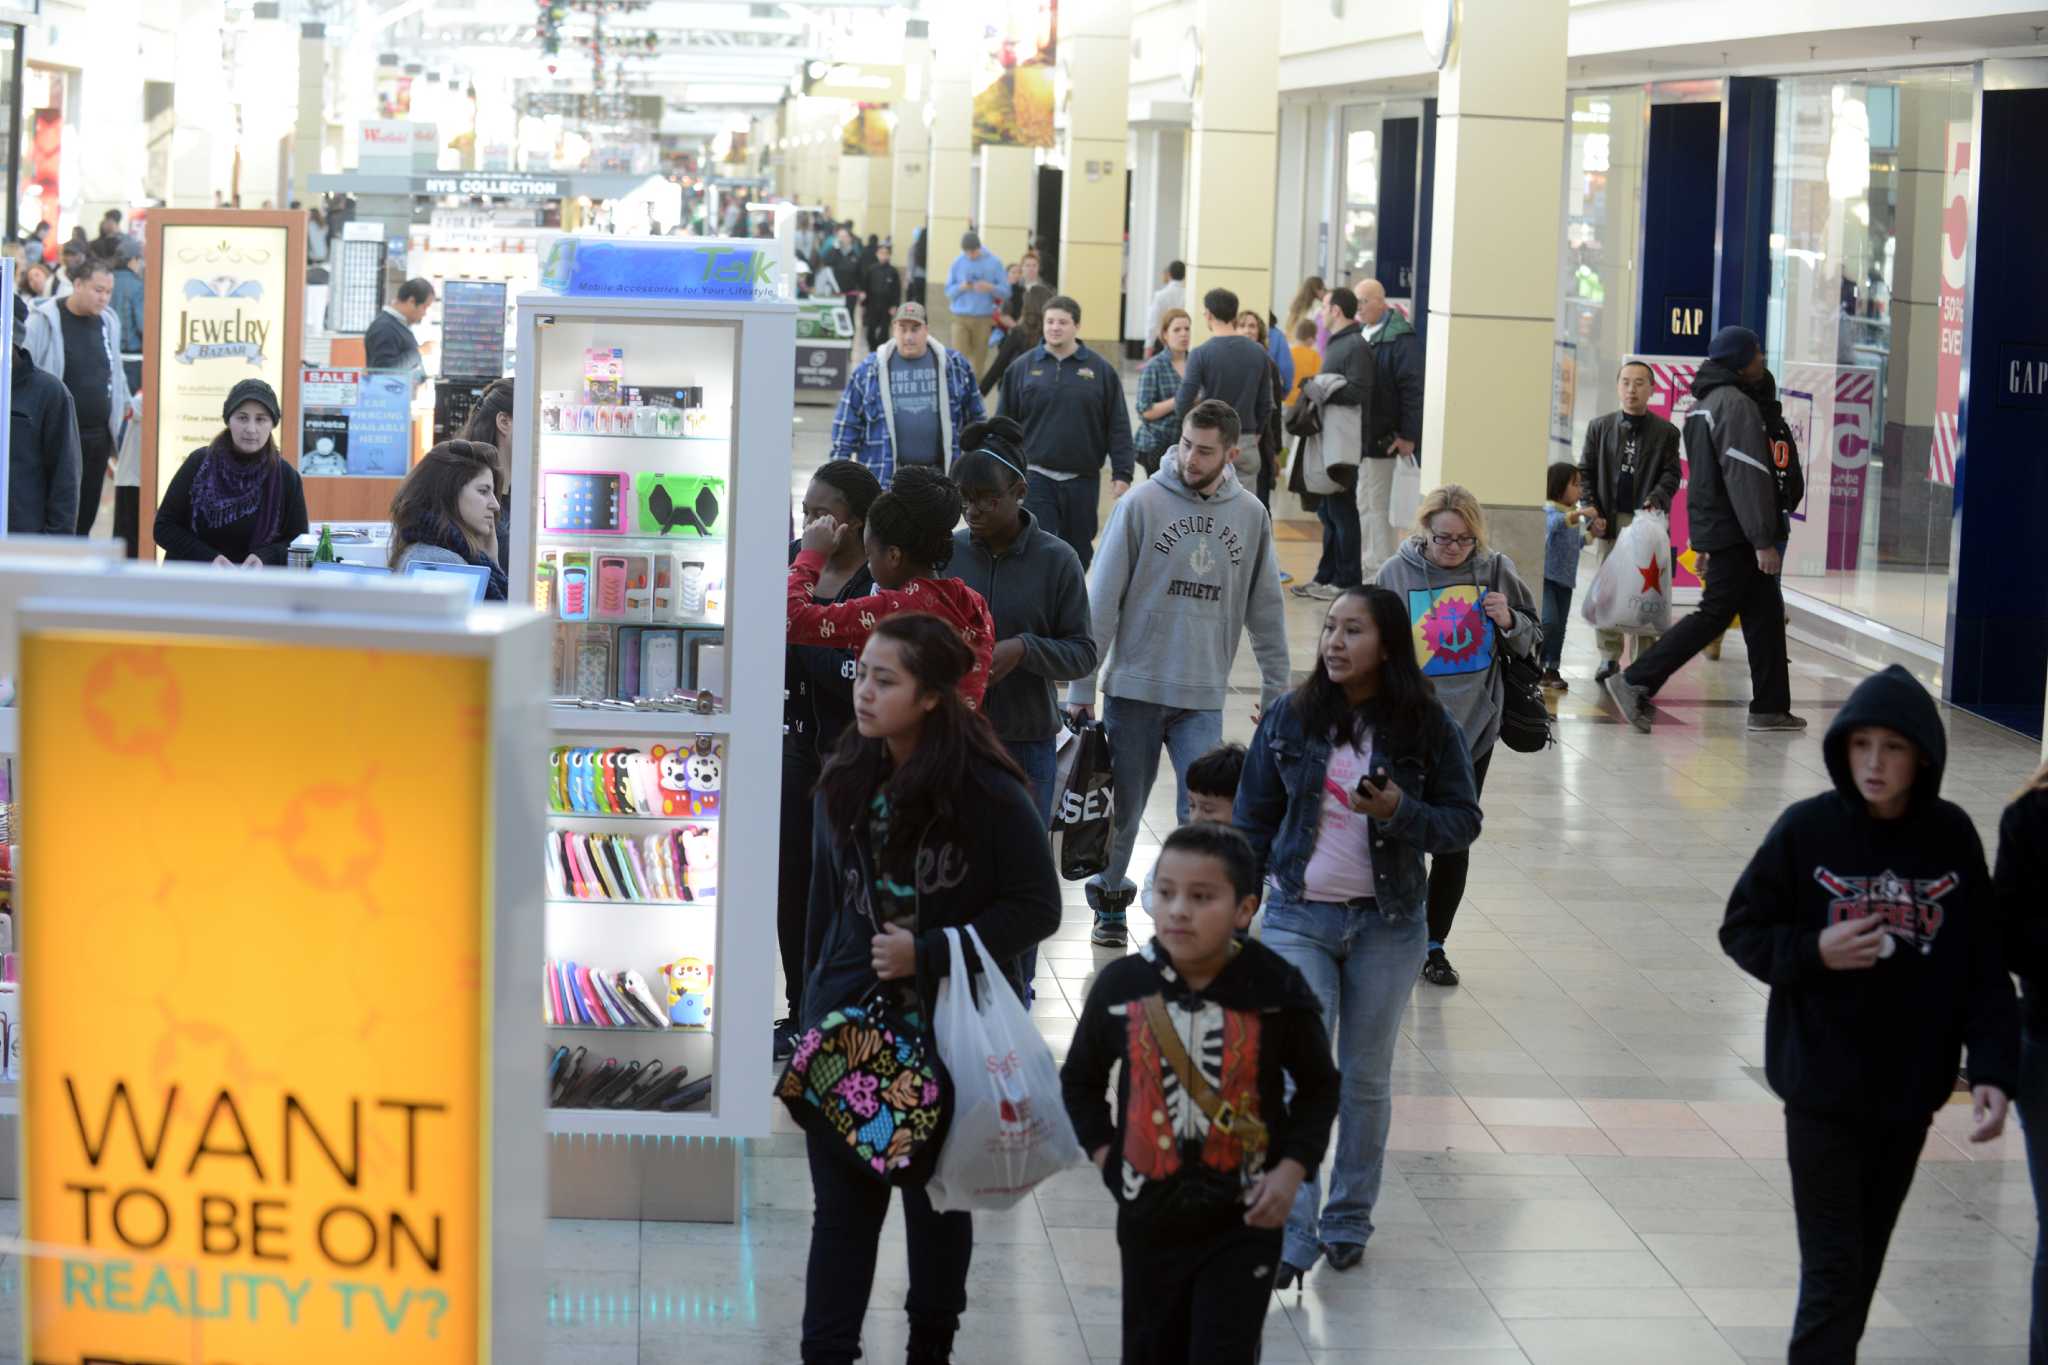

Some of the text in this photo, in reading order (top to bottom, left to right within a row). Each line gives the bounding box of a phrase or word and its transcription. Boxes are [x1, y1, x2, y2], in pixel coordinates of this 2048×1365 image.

[426, 179, 557, 195] NYS COLLECTION
[693, 247, 777, 285] Talk
[578, 281, 775, 298] Mobile Accessories for Your Lifestyle
[1671, 307, 1704, 336] GAP
[198, 345, 248, 358] BAZAAR
[309, 372, 353, 384] SALE
[2009, 359, 2048, 394] GAP
[1154, 515, 1215, 556] BAYSIDE
[64, 1074, 449, 1197] WANT
[64, 1182, 443, 1276] TO BE ON
[61, 1257, 450, 1341] REALITY TV?
